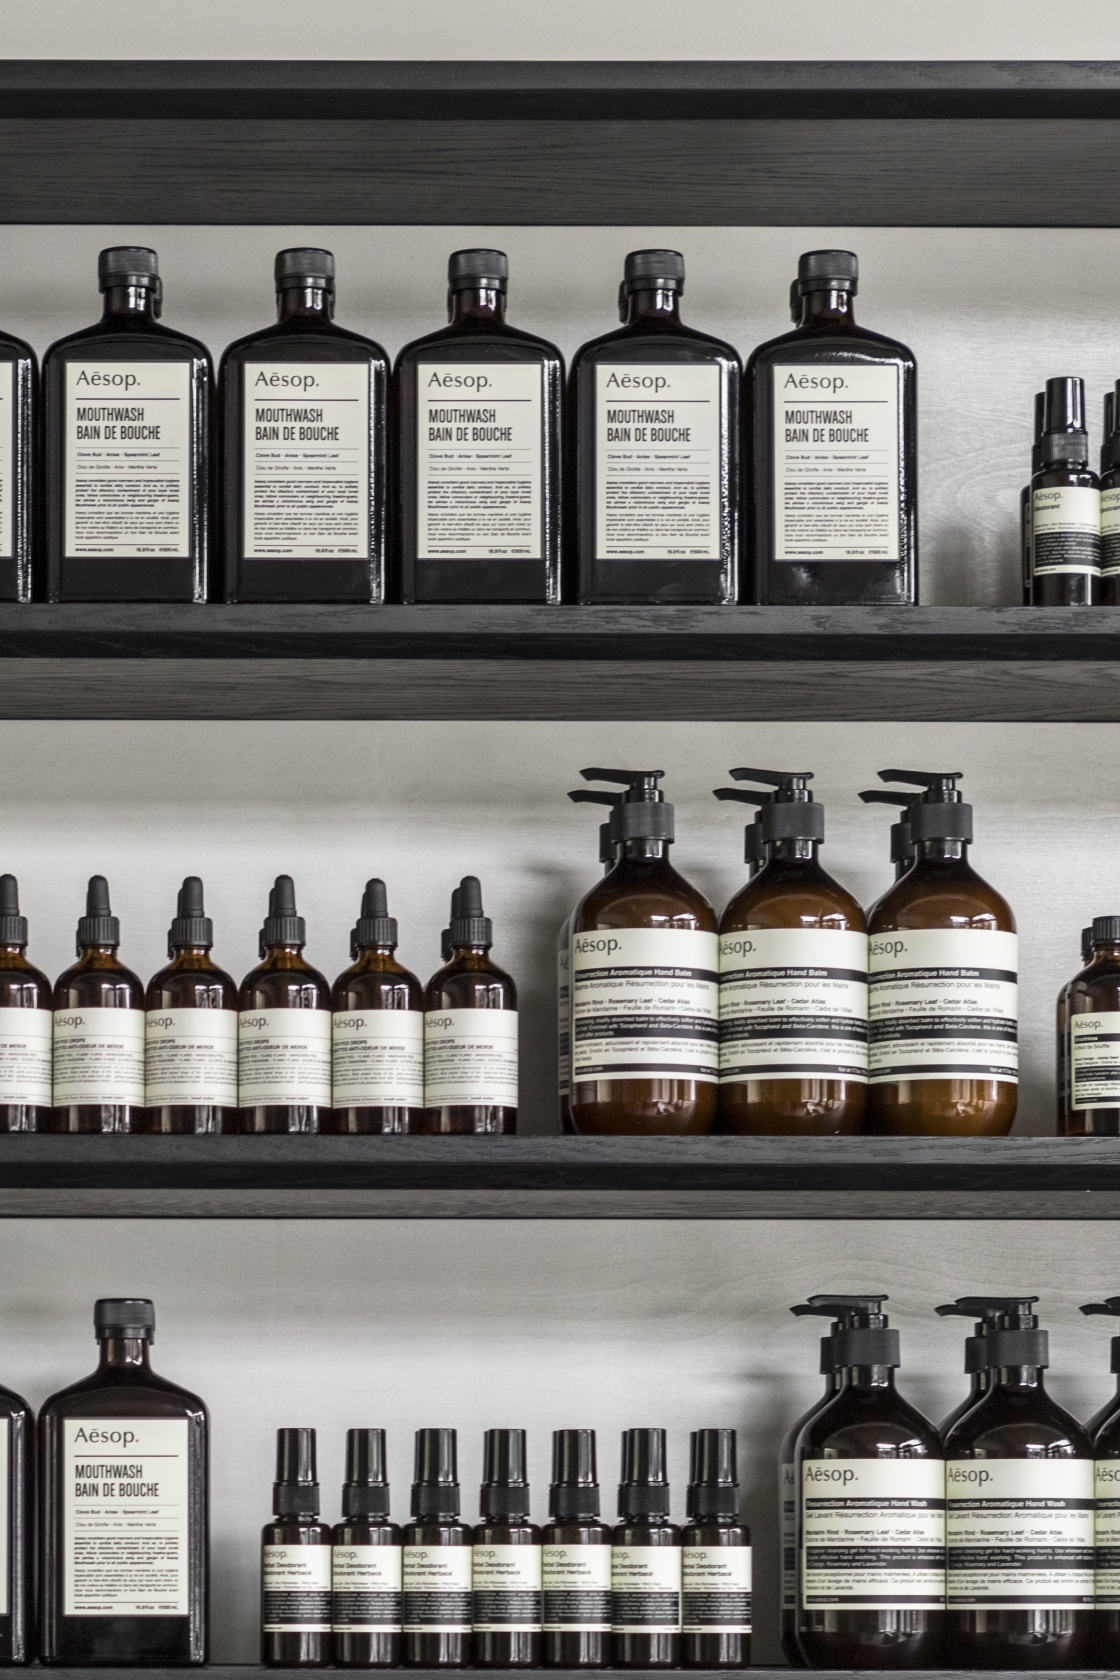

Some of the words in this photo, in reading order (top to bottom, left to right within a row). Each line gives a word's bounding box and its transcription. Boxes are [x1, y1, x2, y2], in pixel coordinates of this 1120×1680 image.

[76, 369, 141, 391] Aēsop.
[254, 370, 319, 392] Aēsop.
[428, 371, 493, 393] Aēsop.
[606, 372, 671, 394] Aēsop.
[784, 372, 849, 394] Aēsop.
[77, 407, 145, 421] MOUTHWASH
[255, 408, 323, 422] MOUTHWASH
[429, 409, 497, 423] MOUTHWASH
[607, 410, 675, 424] MOUTHWASH
[785, 410, 853, 424] MOUTHWASH
[77, 425, 101, 439] BAIN
[105, 425, 117, 439] DE
[120, 425, 161, 440] BOUCHE
[255, 426, 279, 440] BAIN
[283, 426, 295, 440] DE
[298, 426, 339, 441] BOUCHE
[429, 427, 453, 441] BAIN
[457, 427, 469, 441] DE
[472, 427, 513, 442] BOUCHE
[607, 428, 631, 442] BAIN
[635, 428, 647, 442] DE
[650, 428, 691, 443] BOUCHE
[785, 428, 809, 442] BAIN
[813, 428, 825, 442] DE
[828, 428, 869, 443] BOUCHE
[574, 938, 622, 956] Aēsop.
[610, 968, 653, 977] Aromatique
[674, 969, 692, 977] Balm
[786, 969, 808, 977] Hand
[808, 969, 828, 977] Balm
[897, 970, 938, 979] Aromatique
[938, 969, 959, 977] Hand
[960, 969, 980, 977] Balm
[670, 981, 685, 989] pour
[74, 1427, 139, 1449] Aēsop.
[75, 1465, 143, 1479] MOUTHWASH
[804, 1466, 859, 1486] Aēsop.
[75, 1483, 99, 1497] BAIN
[103, 1483, 115, 1497] DE
[118, 1483, 159, 1498] BOUCHE
[845, 1500, 889, 1508] Aromatique
[981, 1500, 1025, 1509] Aromatique
[1025, 1500, 1046, 1508] Hand
[1046, 1500, 1066, 1508] Wash
